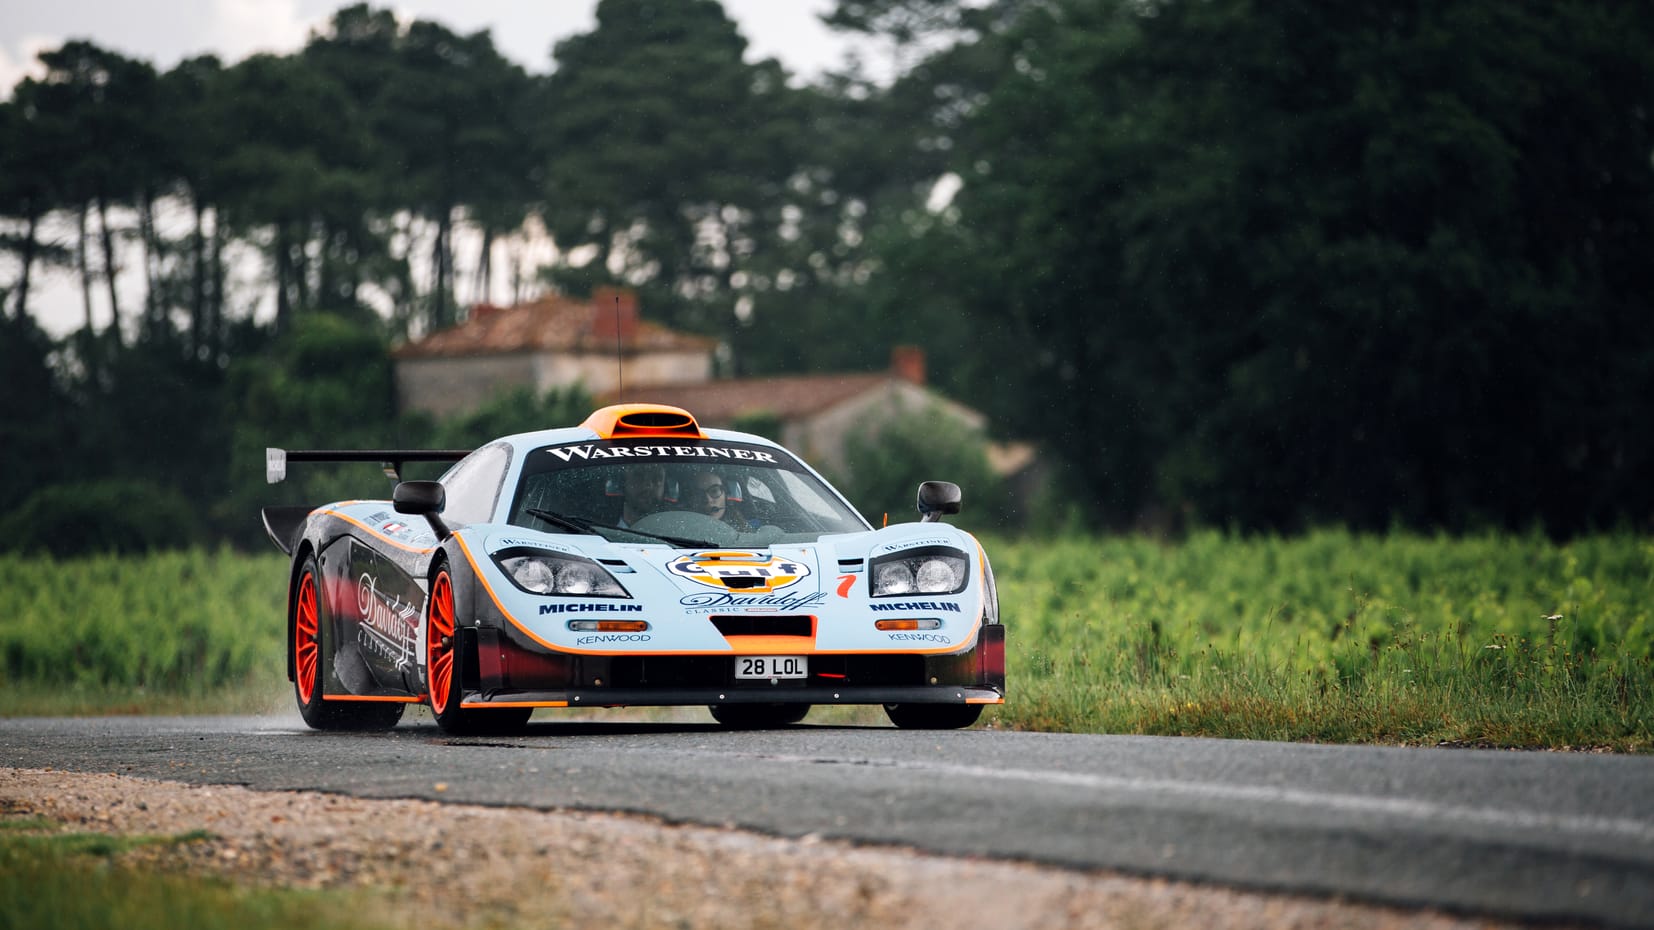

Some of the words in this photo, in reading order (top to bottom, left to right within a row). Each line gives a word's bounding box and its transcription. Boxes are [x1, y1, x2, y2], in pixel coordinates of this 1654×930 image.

[546, 444, 778, 463] WARSTEINER
[674, 561, 803, 577] Gulf
[679, 591, 828, 611] Davidoff
[539, 603, 643, 615] MICHELIN
[685, 606, 740, 615] CLASSIC
[869, 602, 961, 613] MICHELIN
[576, 634, 652, 646] KENWOOD
[889, 633, 951, 645] KENWOOD
[742, 659, 766, 675] 28
[772, 659, 804, 675] LOL
